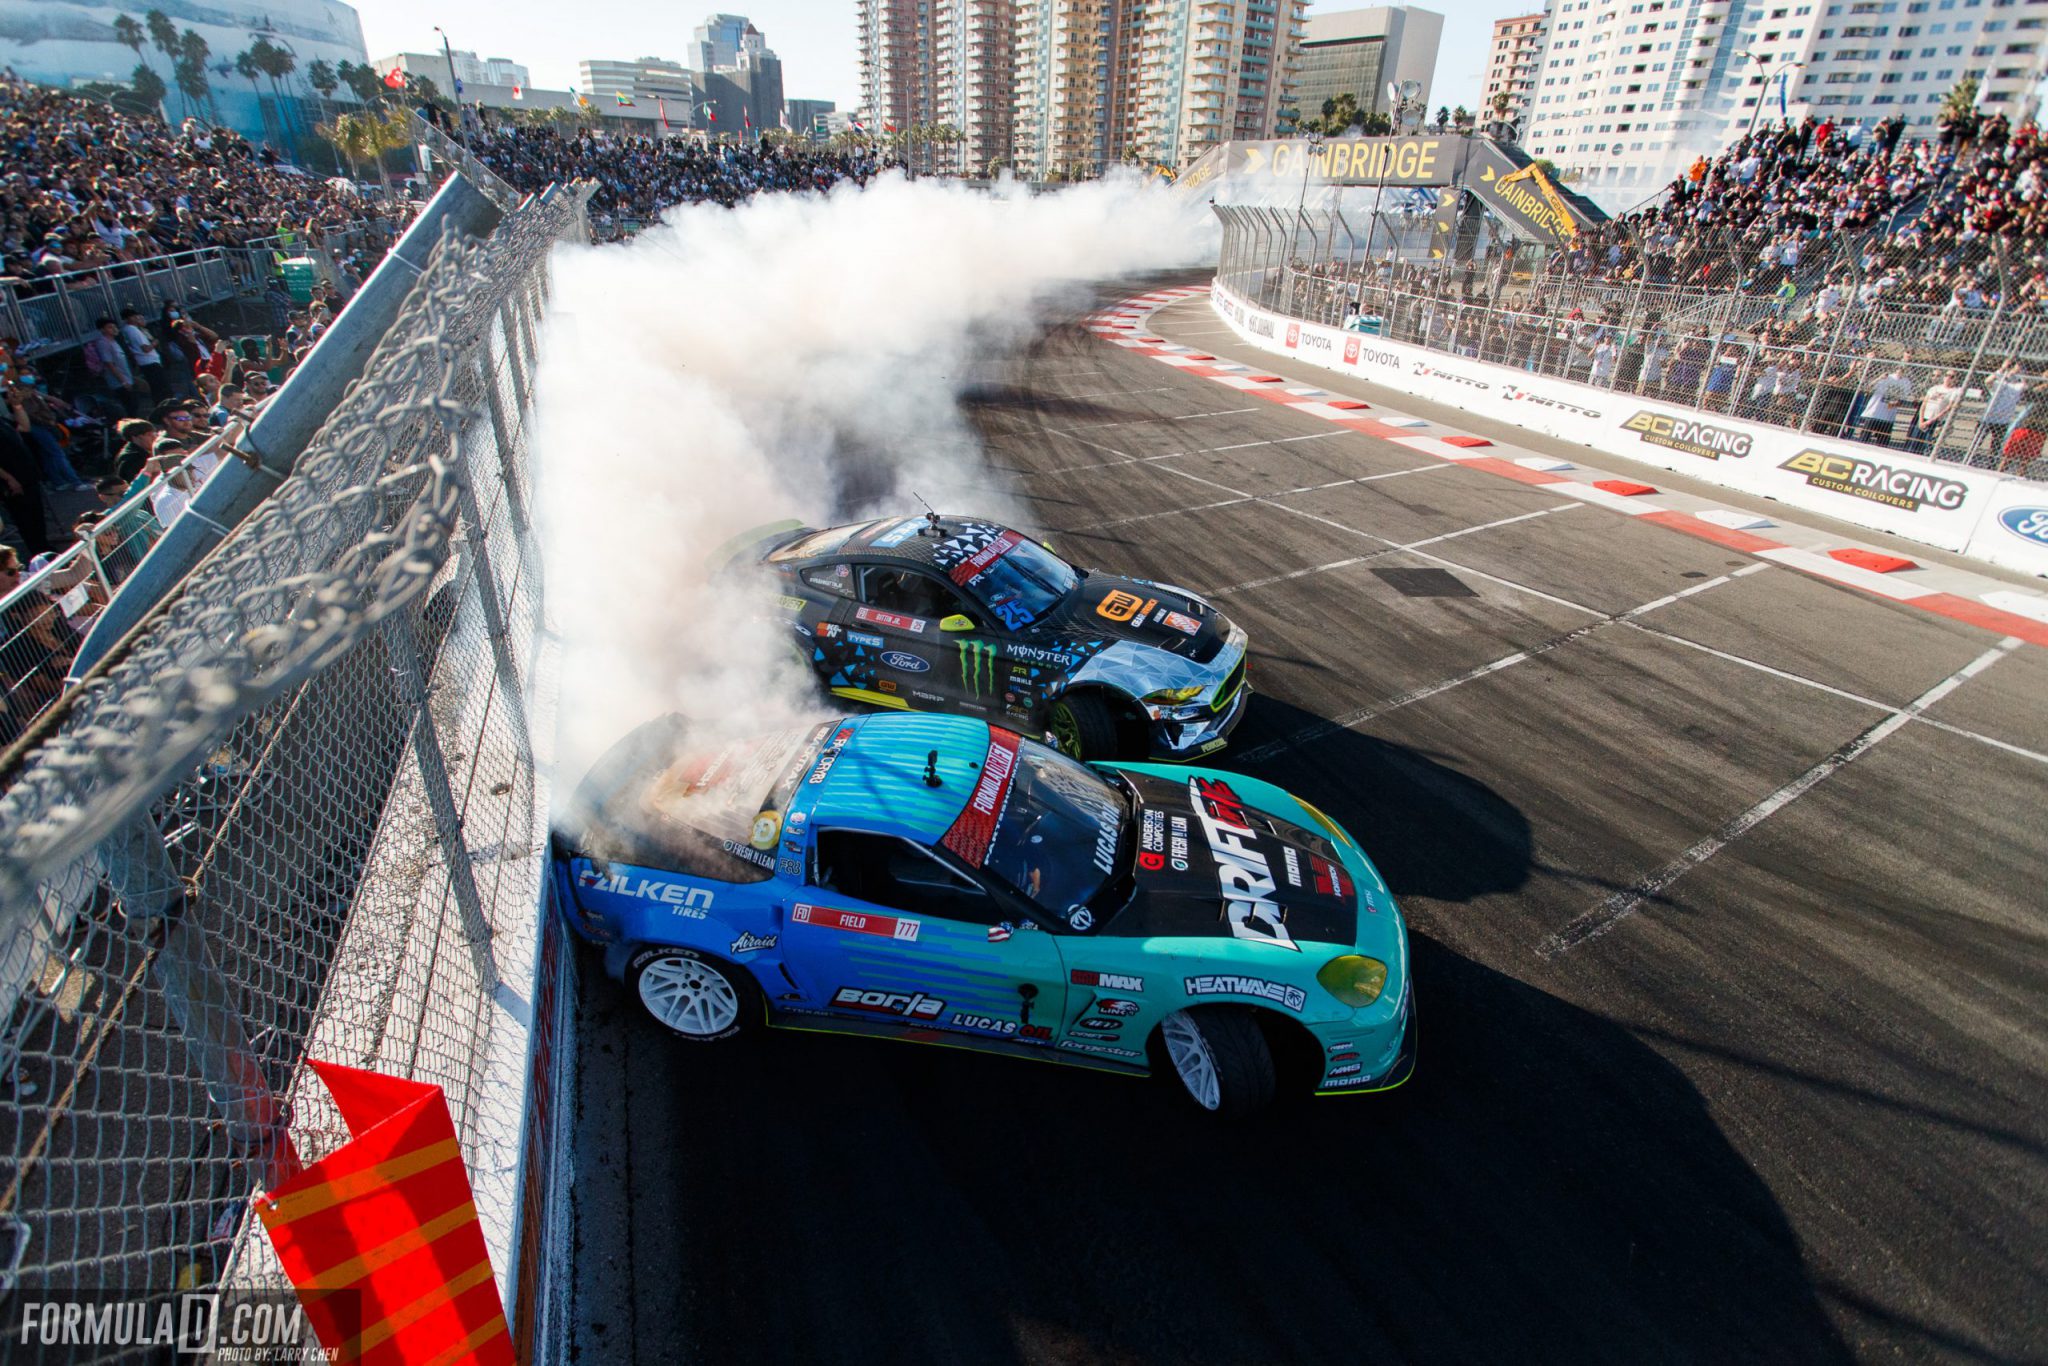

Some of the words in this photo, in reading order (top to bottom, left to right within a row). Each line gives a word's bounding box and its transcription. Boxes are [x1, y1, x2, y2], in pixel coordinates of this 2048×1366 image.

[1301, 333, 1331, 350] TOYOTA
[1363, 347, 1400, 368] TOYOTA
[1527, 395, 1602, 419] NITTO
[1644, 434, 1673, 448] CUSTOM
[1674, 442, 1716, 459] COILOVERS
[1812, 477, 1853, 493] CUSTOM
[1854, 487, 1914, 510] COILOVERS
[995, 600, 1035, 632] 25
[889, 653, 921, 670] Ford
[1006, 644, 1070, 665] MONSTER
[1142, 809, 1154, 850] ANDERSON
[1153, 810, 1164, 852] COMPOSITES
[1171, 816, 1187, 831] LEAN
[733, 843, 754, 860] FRESH
[758, 853, 776, 871] LEAN
[1171, 837, 1188, 859] FRESH
[672, 905, 708, 919] TIRES
[839, 913, 866, 929] FIELD
[897, 921, 919, 939] 777
[731, 932, 777, 953] Airaid
[1186, 976, 1285, 1001] HEATWAVE
[952, 1014, 1016, 1035] LUCAS
[1019, 1025, 1053, 1040] OIL
